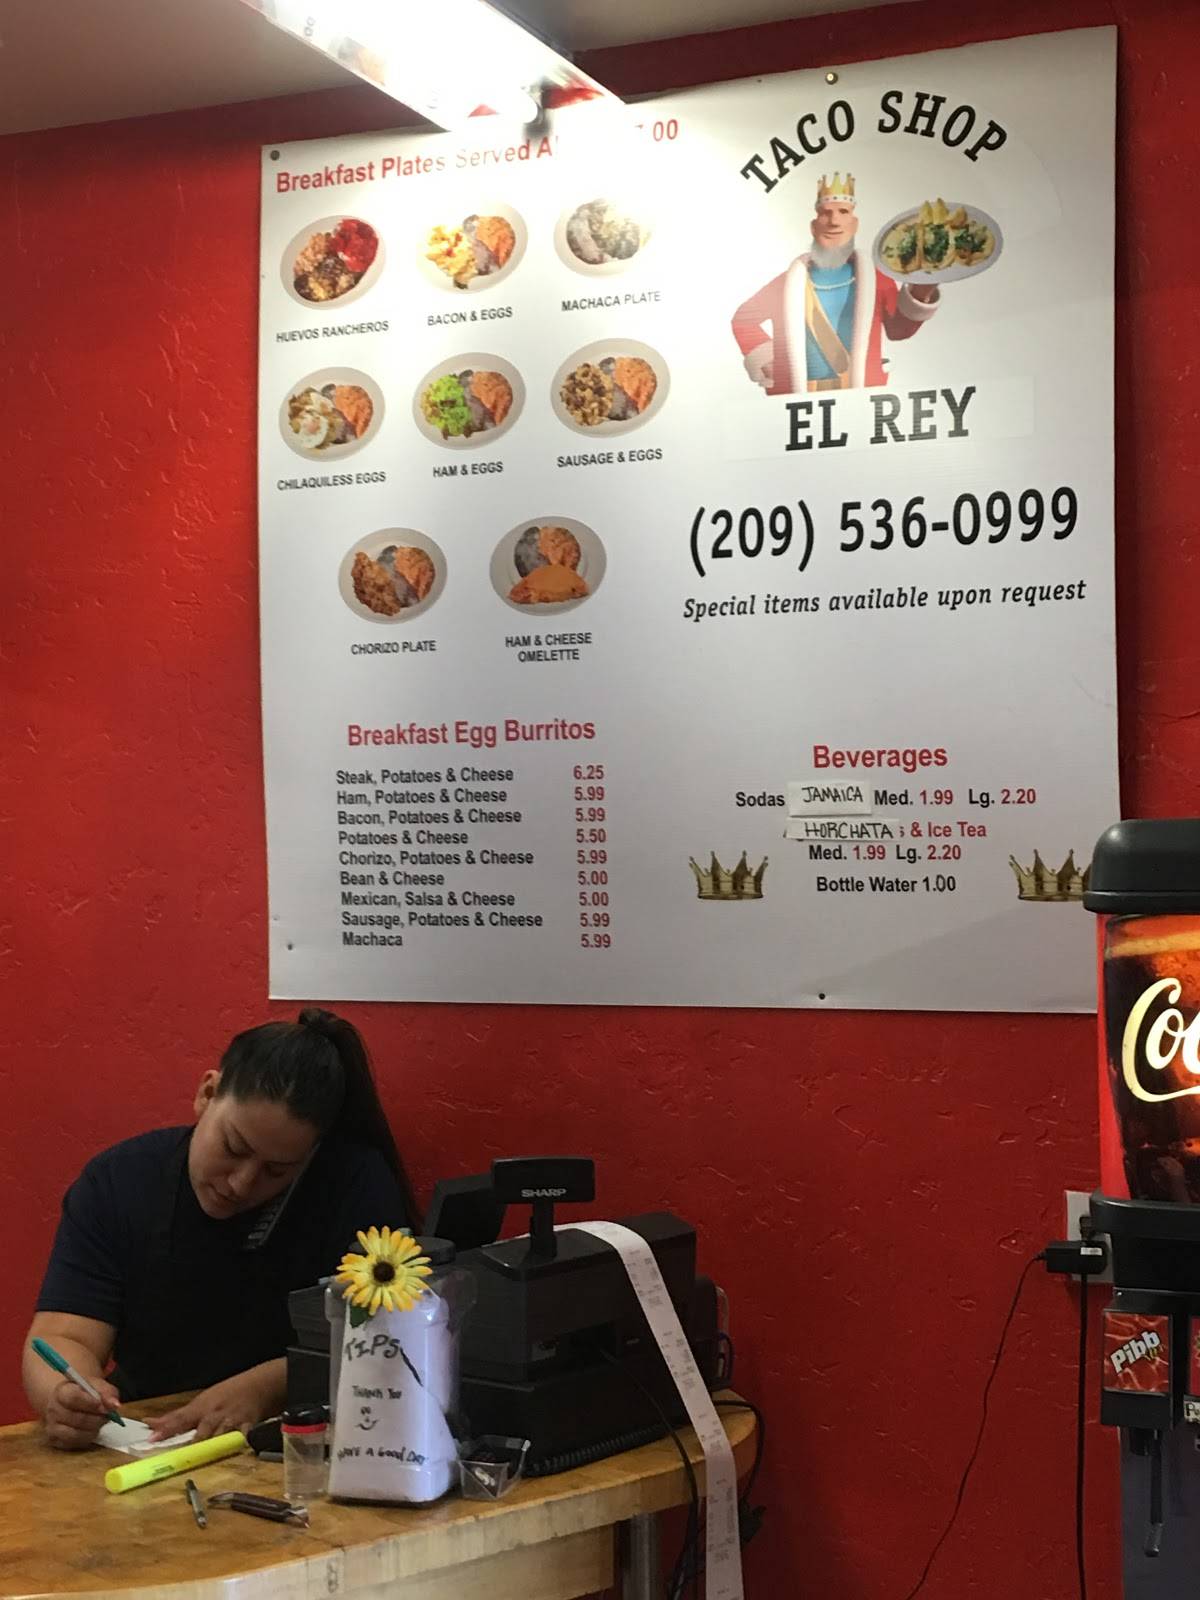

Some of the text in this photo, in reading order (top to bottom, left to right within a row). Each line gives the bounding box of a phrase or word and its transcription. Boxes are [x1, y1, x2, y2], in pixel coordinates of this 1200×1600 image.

[740, 90, 1007, 194] TACO SHOP
[276, 162, 375, 193] Breakfast
[381, 156, 446, 179] Plates
[455, 140, 530, 168] Served
[561, 291, 662, 312] MACHACA PLATE
[427, 306, 513, 326] BACON & EGGS
[276, 320, 390, 344] HUEVOS RANCHEROS
[785, 386, 976, 451] EL REY
[557, 448, 663, 468] SAUSAGE & EGGS
[432, 461, 504, 478] HAM & EGGS
[276, 471, 386, 491] CHILAQUILESS EGGS
[690, 486, 1078, 578] (209) 536-0999
[683, 579, 1087, 622] Special items available upon request
[351, 640, 437, 655] CHORIZO PLATE
[505, 632, 592, 648] HAM & CHEESE
[518, 649, 579, 662] OMELETTE
[348, 718, 596, 749] Breakfast Egg Burritos
[813, 744, 948, 773] Beverages
[336, 765, 604, 785] Steak, Potatoes & Cheese 6.25
[337, 785, 605, 807] Ham, Potatoes & Cheese 5.99
[735, 788, 1037, 809] Sodas Med. 1.99 Lg. 2.20
[801, 786, 864, 804] JAMAICA
[337, 806, 606, 827] Bacon, Potatoes & Cheese 5.99
[338, 828, 607, 846] Potatoes & Cheese 5.50
[804, 821, 894, 841] HORCHATA
[910, 821, 923, 838] &
[927, 822, 952, 838] Ice
[957, 821, 987, 838] Tea
[339, 848, 607, 868] Chorizo, Potatoes & Cheese 5.99
[809, 845, 962, 864] Med. 1.99 Lg. 2.20
[340, 870, 609, 886] Bean & Cheese 5.00
[816, 875, 956, 892] Bottle Water 1.00
[341, 891, 609, 909] Mexican, Salsa & Cheese 5.00
[342, 911, 610, 930] Sausage, Potatoes & Cheese 5.99
[342, 932, 611, 949] Machaca 5.99
[521, 1188, 567, 1198] SHARP
[345, 1334, 400, 1361] TIPS
[1110, 1331, 1160, 1373] Pibb
